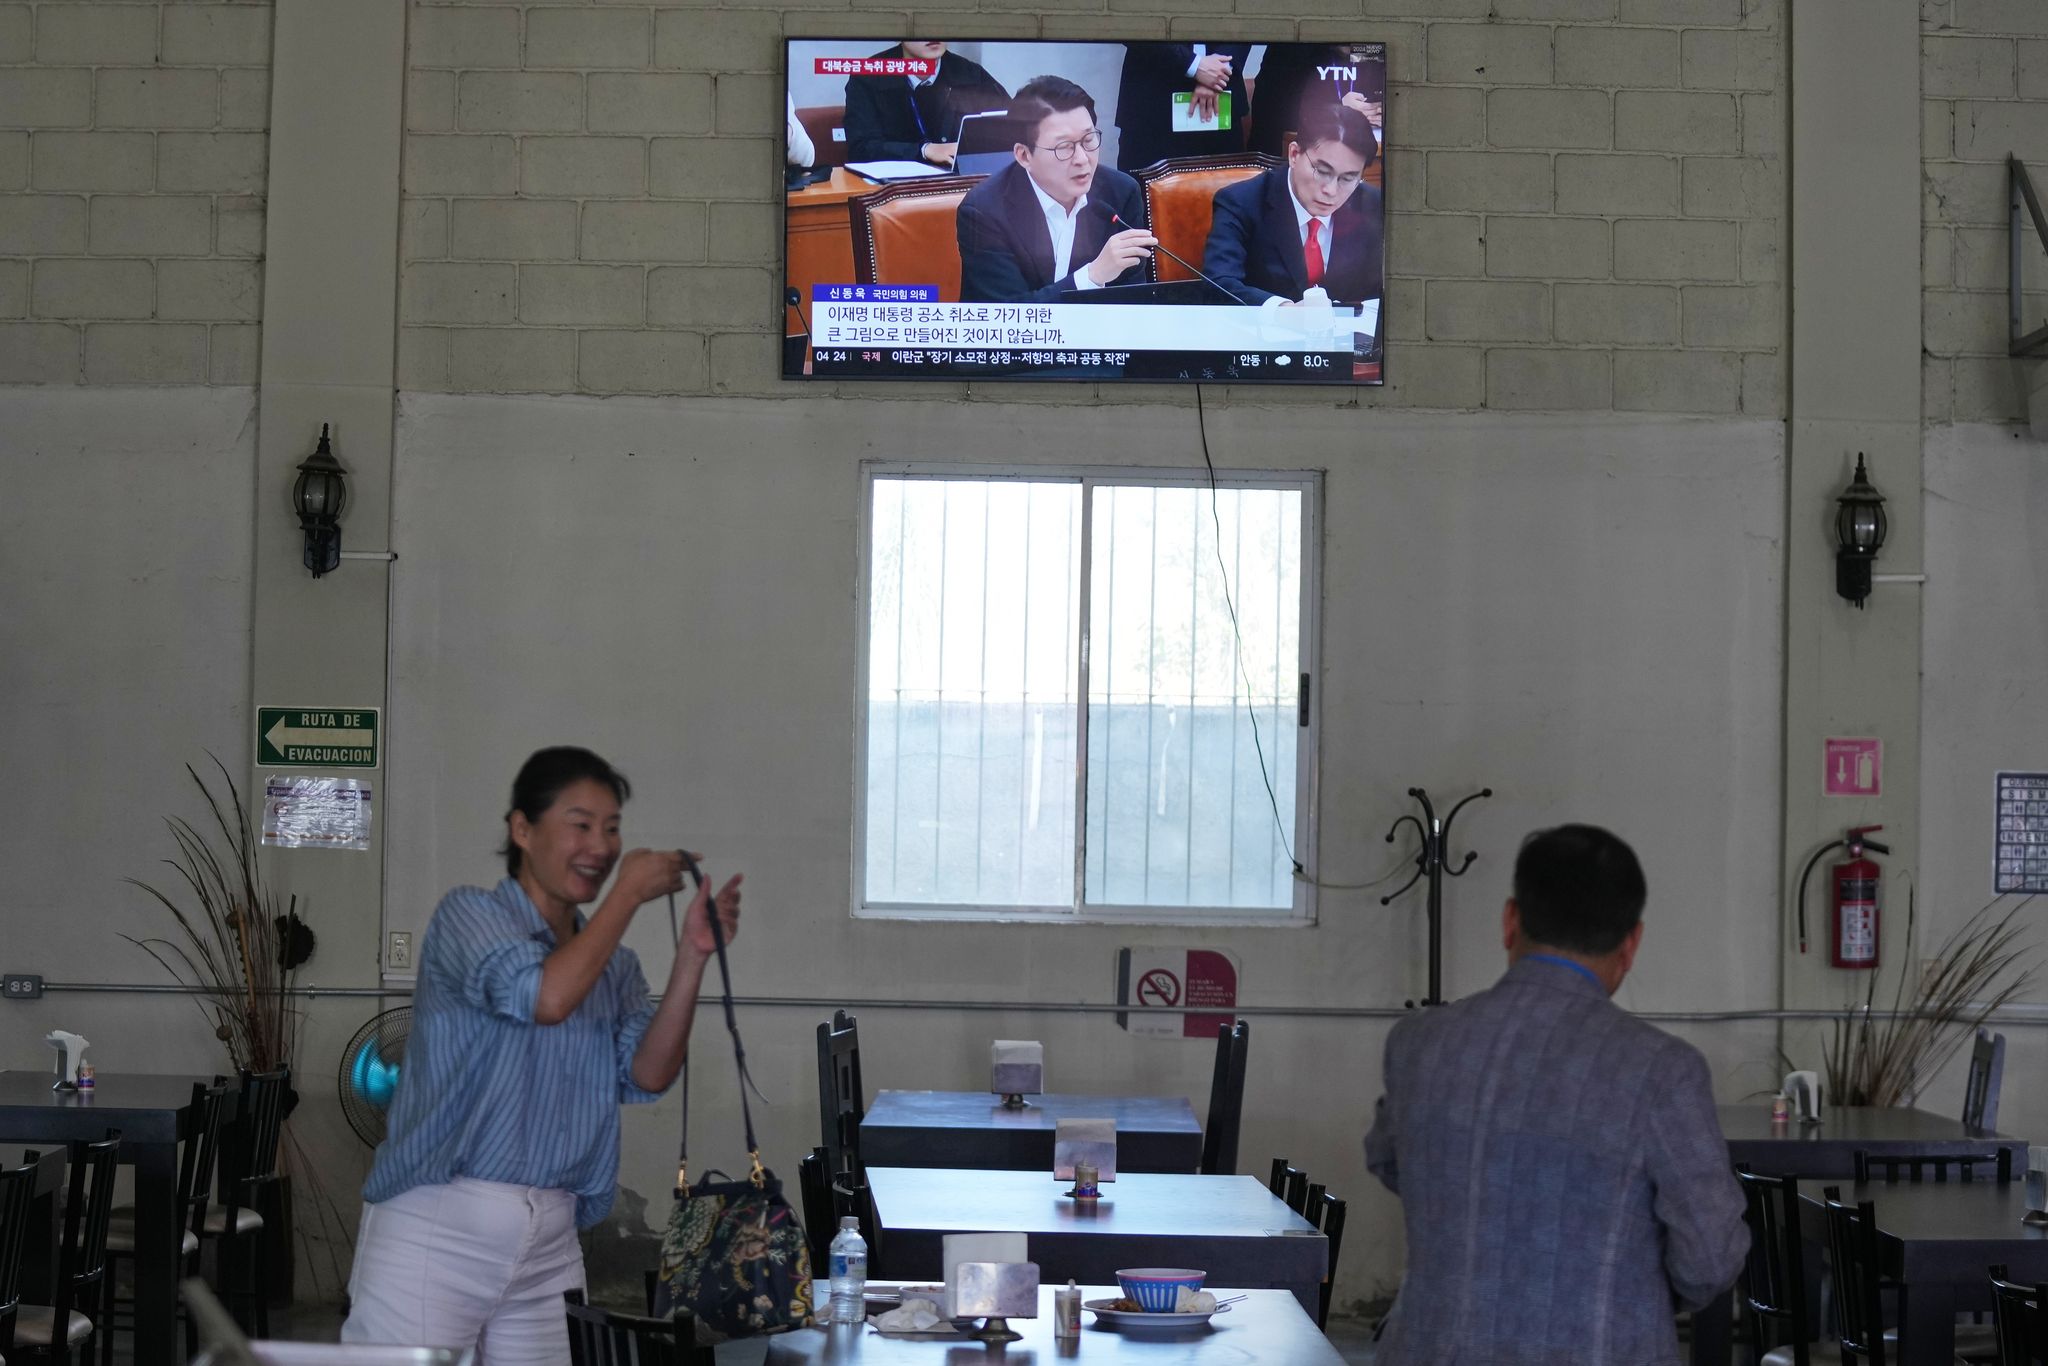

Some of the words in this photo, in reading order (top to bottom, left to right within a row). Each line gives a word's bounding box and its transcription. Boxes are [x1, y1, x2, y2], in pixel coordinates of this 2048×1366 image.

[822, 60, 862, 73] 대북송금
[864, 60, 883, 73] 녹취
[885, 60, 906, 73] 공방
[908, 60, 928, 73] 계속
[1317, 66, 1357, 81] YTN
[872, 289, 908, 300] 국민의힘
[910, 289, 928, 300] 의원
[828, 306, 868, 322] 이재명
[873, 306, 913, 323] 대통령
[917, 307, 945, 323] 공소
[949, 307, 989, 323] 취소로
[994, 308, 1020, 323] 가기
[1025, 307, 1052, 323] 위한
[828, 327, 841, 342] 큰
[845, 327, 900, 343] 그림으로
[904, 327, 958, 343] 만들어진
[963, 328, 1003, 344] 것이지
[1007, 328, 1065, 344] 않습니까.
[816, 351, 829, 361] 04
[833, 351, 846, 361] 24
[861, 351, 881, 362] 국제
[892, 351, 924, 363] 이란군
[926, 351, 952, 364] "장기
[954, 351, 987, 364] 소모전
[1056, 352, 1078, 365] 축과
[1080, 352, 1102, 365] 공동
[1240, 354, 1261, 367] 안동
[301, 713, 336, 726] RUTA
[343, 714, 360, 727] DE
[288, 748, 372, 762] EVACUACION
